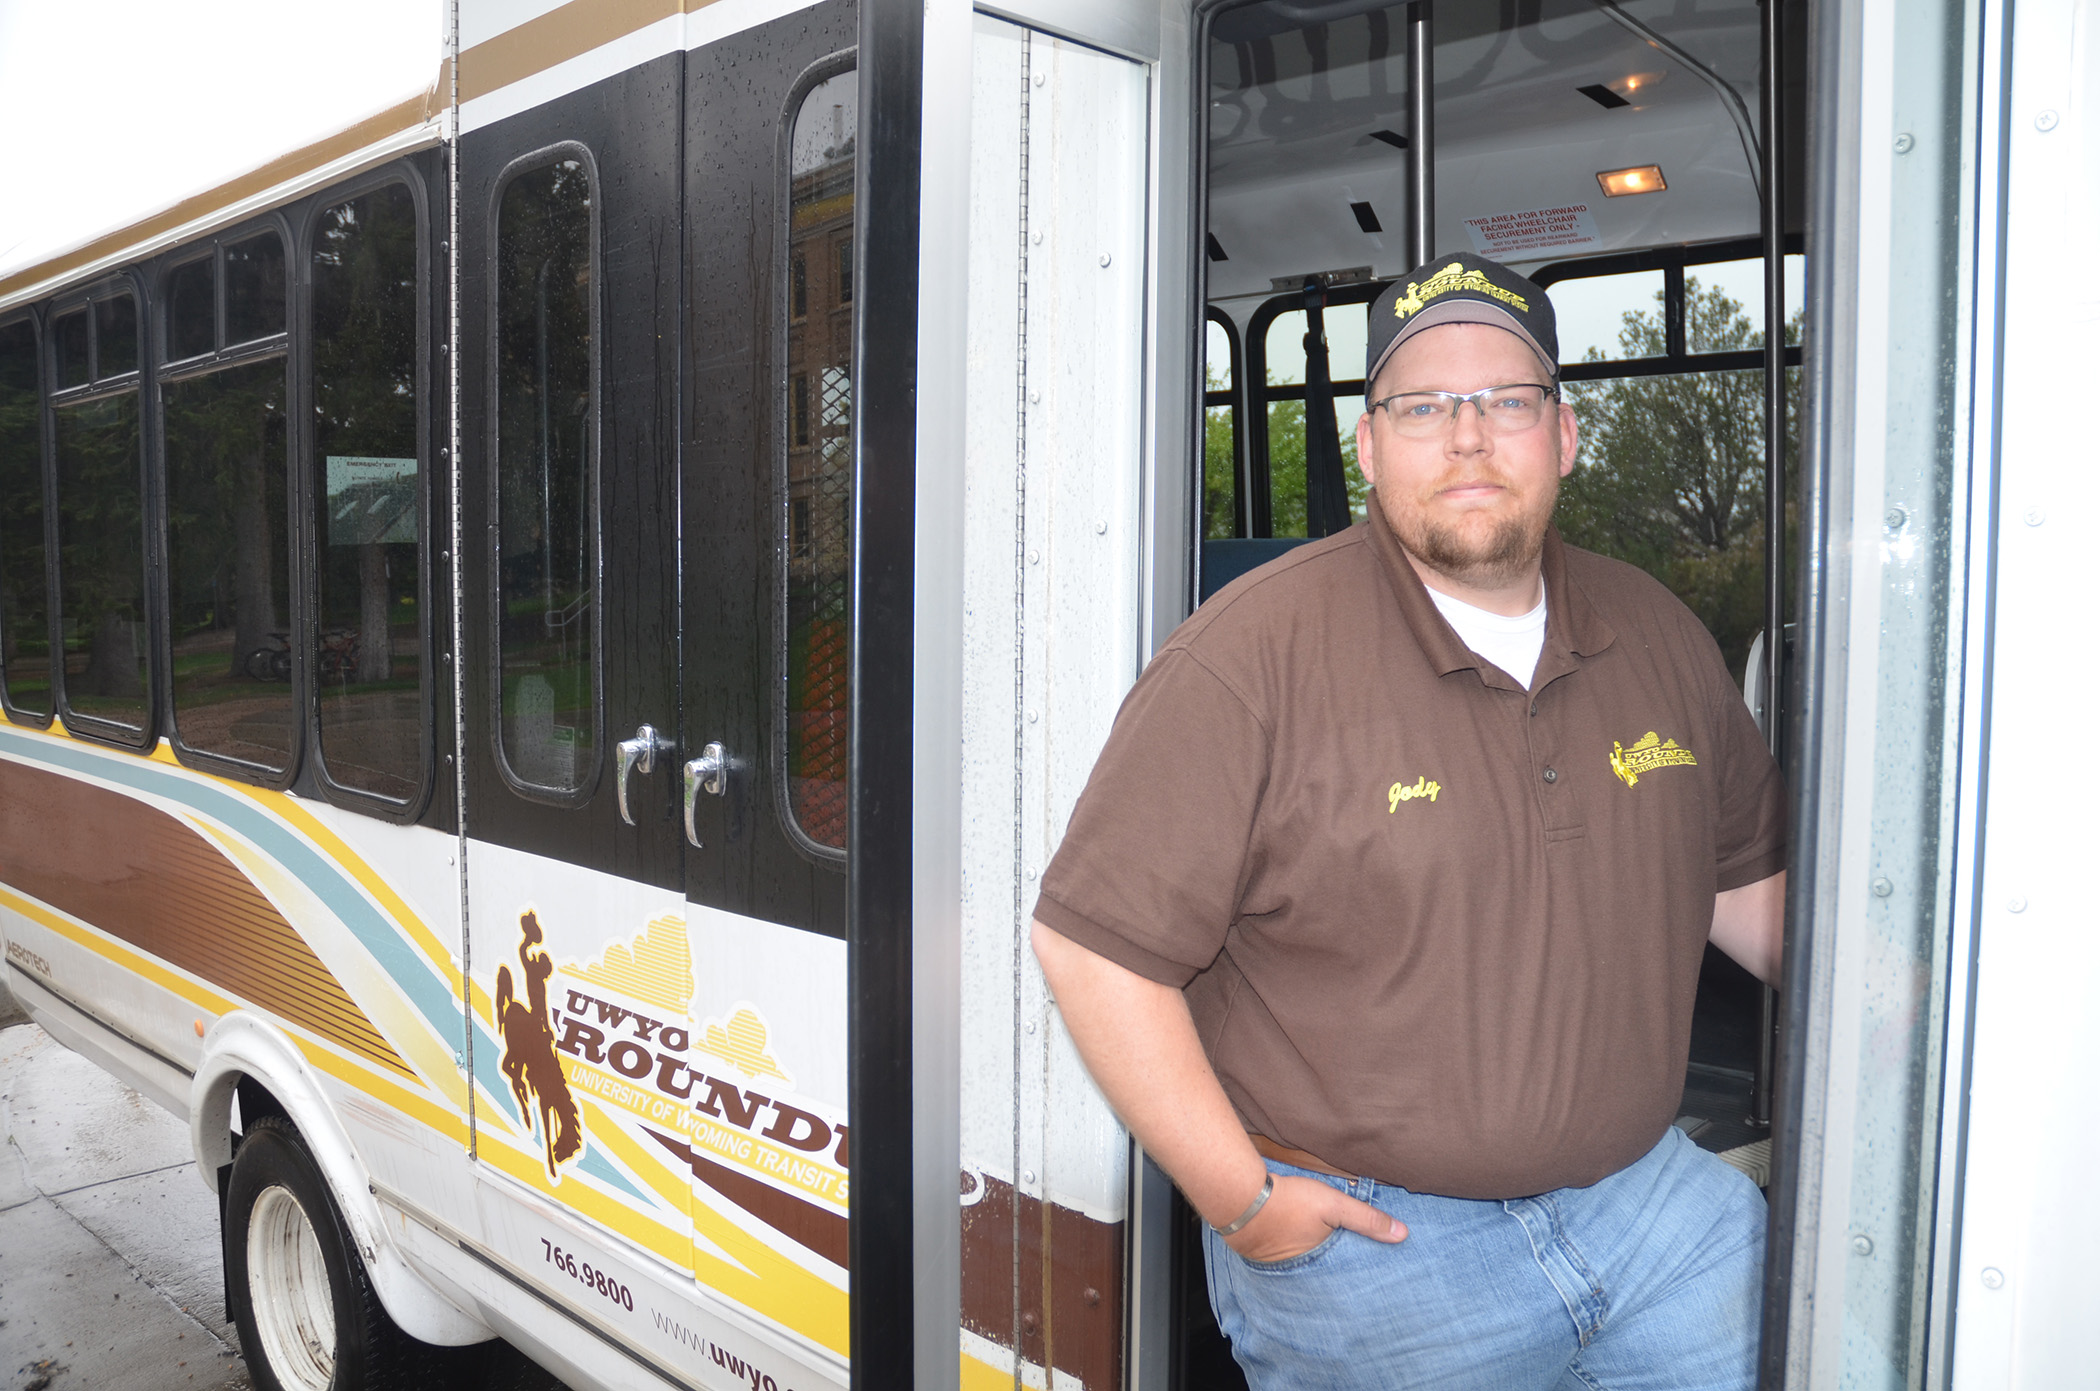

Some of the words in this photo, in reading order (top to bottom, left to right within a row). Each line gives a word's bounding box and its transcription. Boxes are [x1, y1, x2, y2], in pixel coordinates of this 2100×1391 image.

[1480, 222, 1514, 233] FACING
[1514, 214, 1577, 228] WHEELCHAIR
[1484, 226, 1546, 240] SECUREMENT
[1549, 223, 1573, 232] ONLY
[1491, 214, 1516, 223] AREA
[1517, 211, 1537, 220] FOR
[1539, 204, 1587, 217] FORWARD
[1388, 775, 1442, 814] Jody
[566, 989, 689, 1052] UWYO
[571, 1065, 652, 1112] UNIVERSITY
[651, 1101, 675, 1121] OF
[676, 1107, 753, 1159] WYOMING
[755, 1145, 837, 1192] TRANSIT
[541, 1237, 633, 1312] 766.9800
[651, 1307, 795, 1391] www.uwyo
